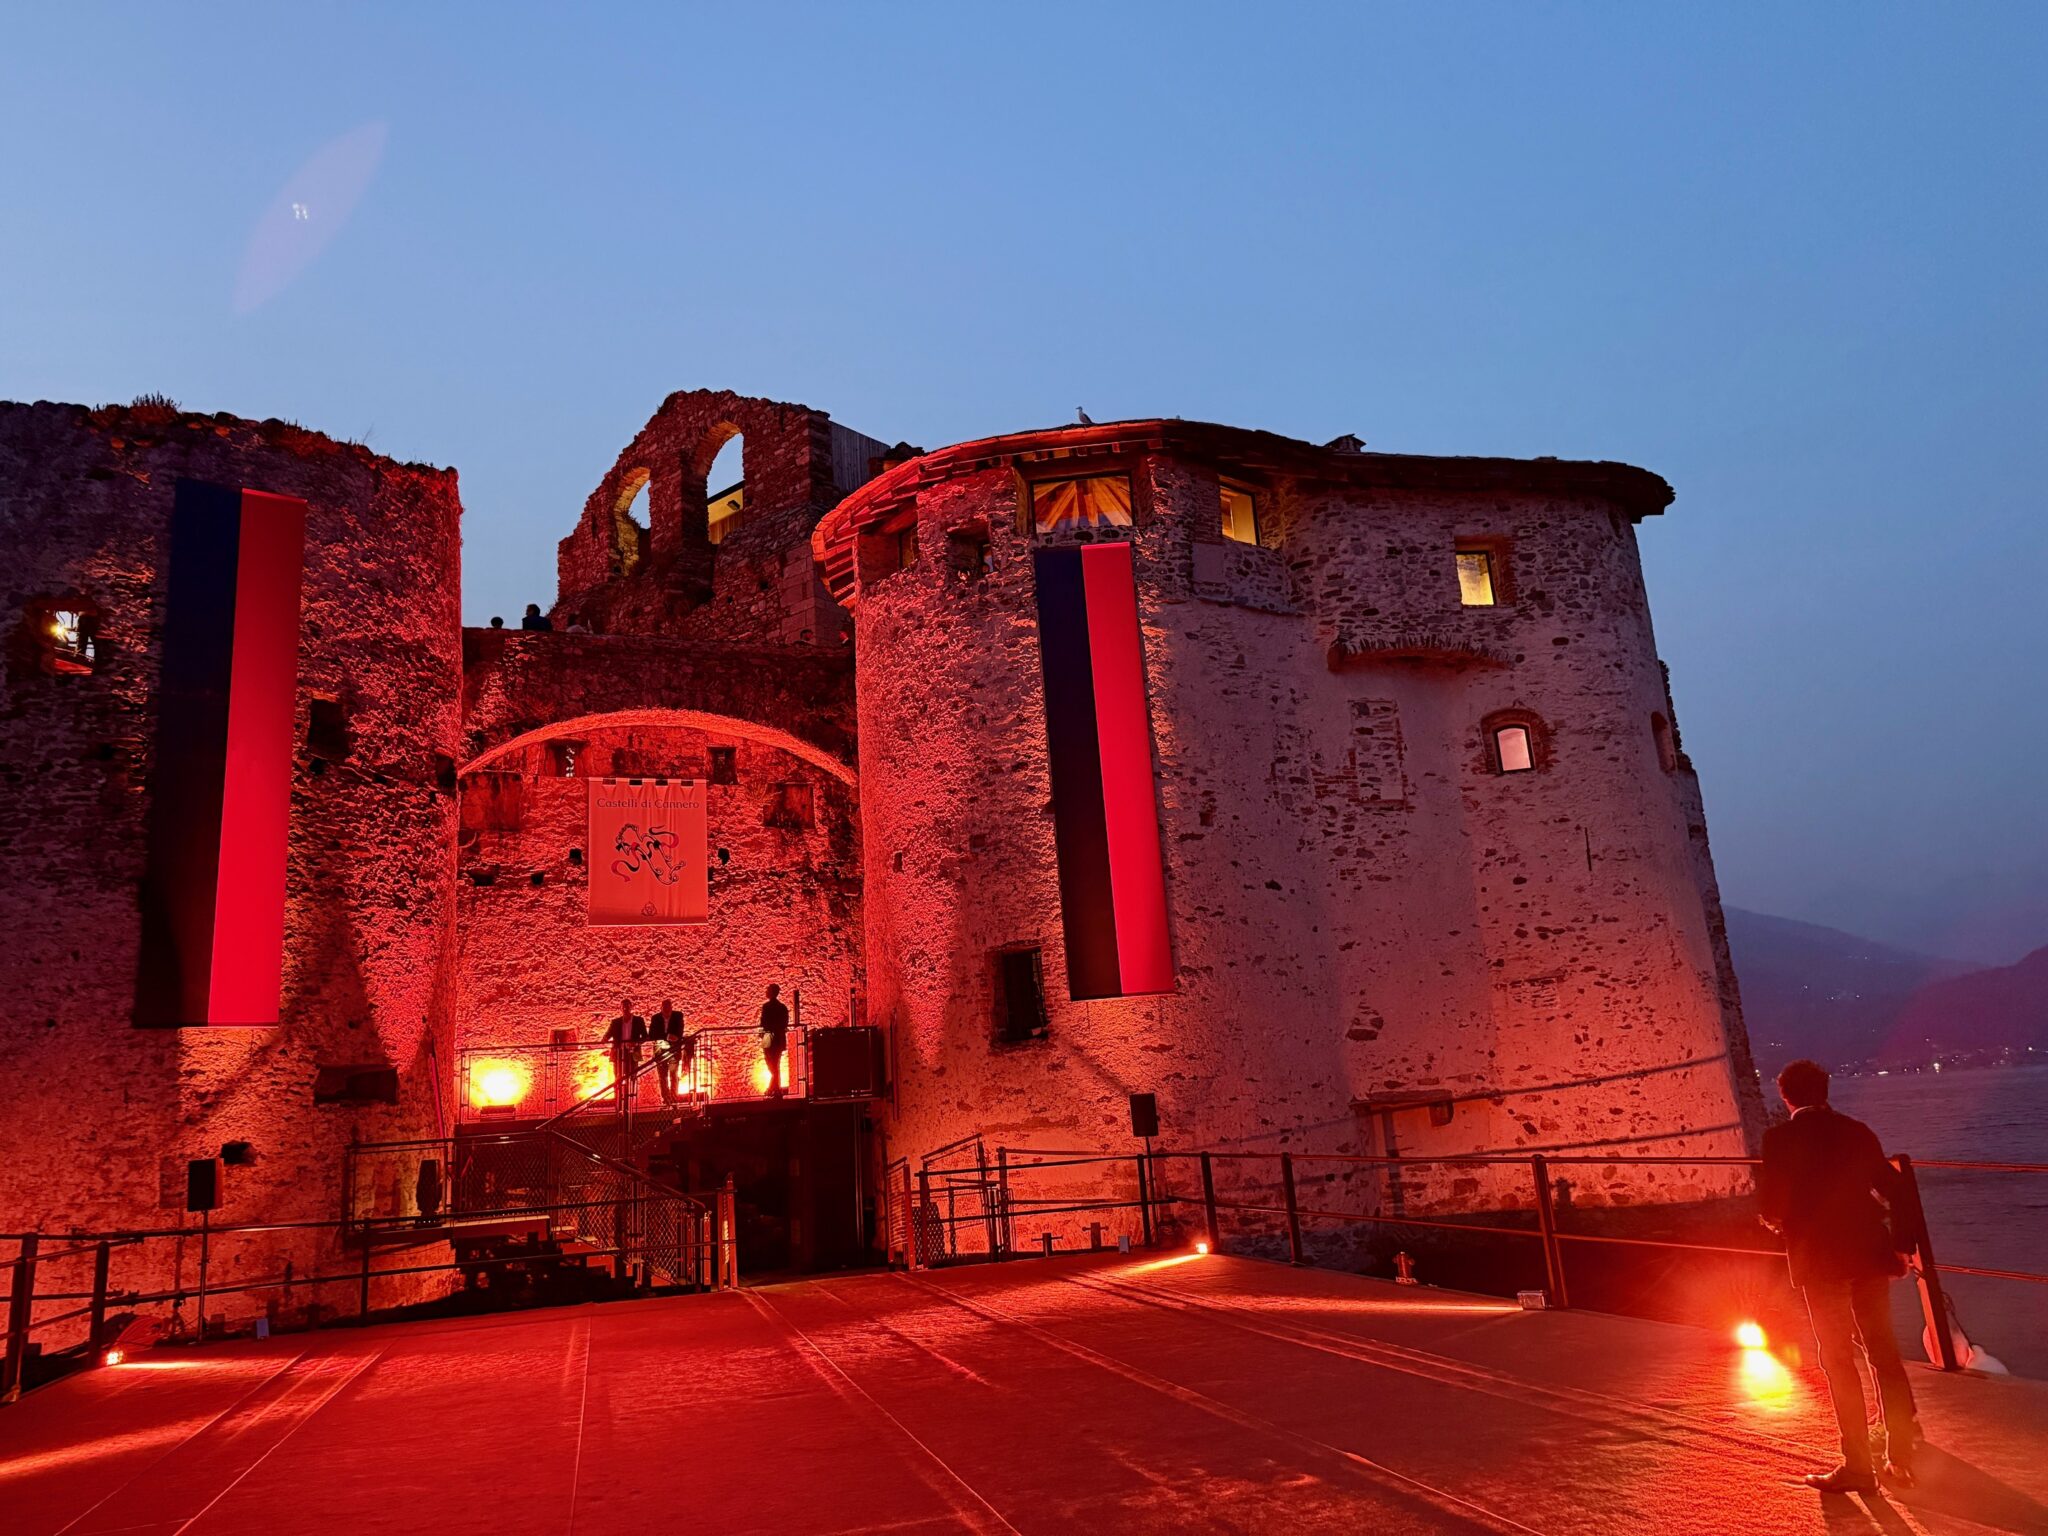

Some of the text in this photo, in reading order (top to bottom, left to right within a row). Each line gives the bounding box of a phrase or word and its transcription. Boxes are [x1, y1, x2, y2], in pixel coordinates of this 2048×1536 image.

[597, 798, 700, 809] Castelli di Cannero
